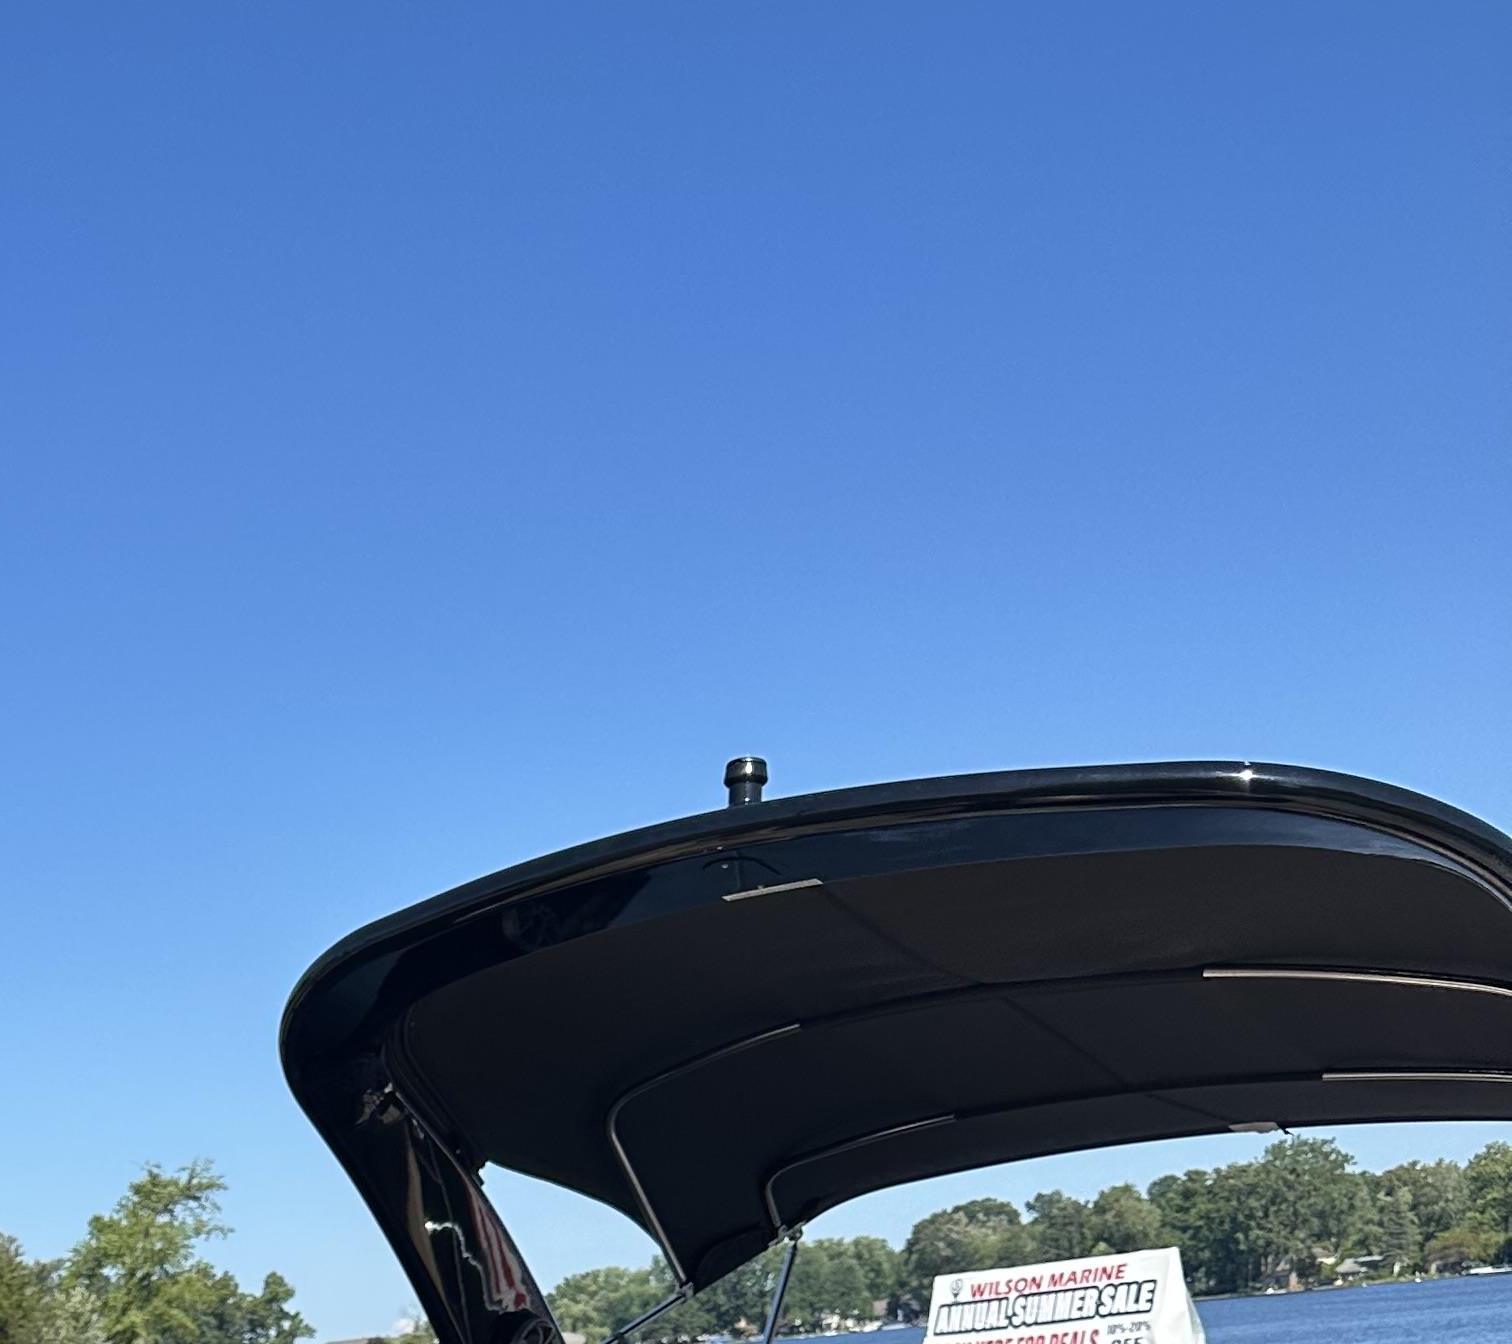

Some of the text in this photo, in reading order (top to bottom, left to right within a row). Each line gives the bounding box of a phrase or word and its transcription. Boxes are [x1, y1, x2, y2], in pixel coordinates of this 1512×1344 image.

[970, 1263, 1127, 1298] WILSON MARINE
[933, 1279, 1157, 1336] ANNUAL SUMMER SALE
